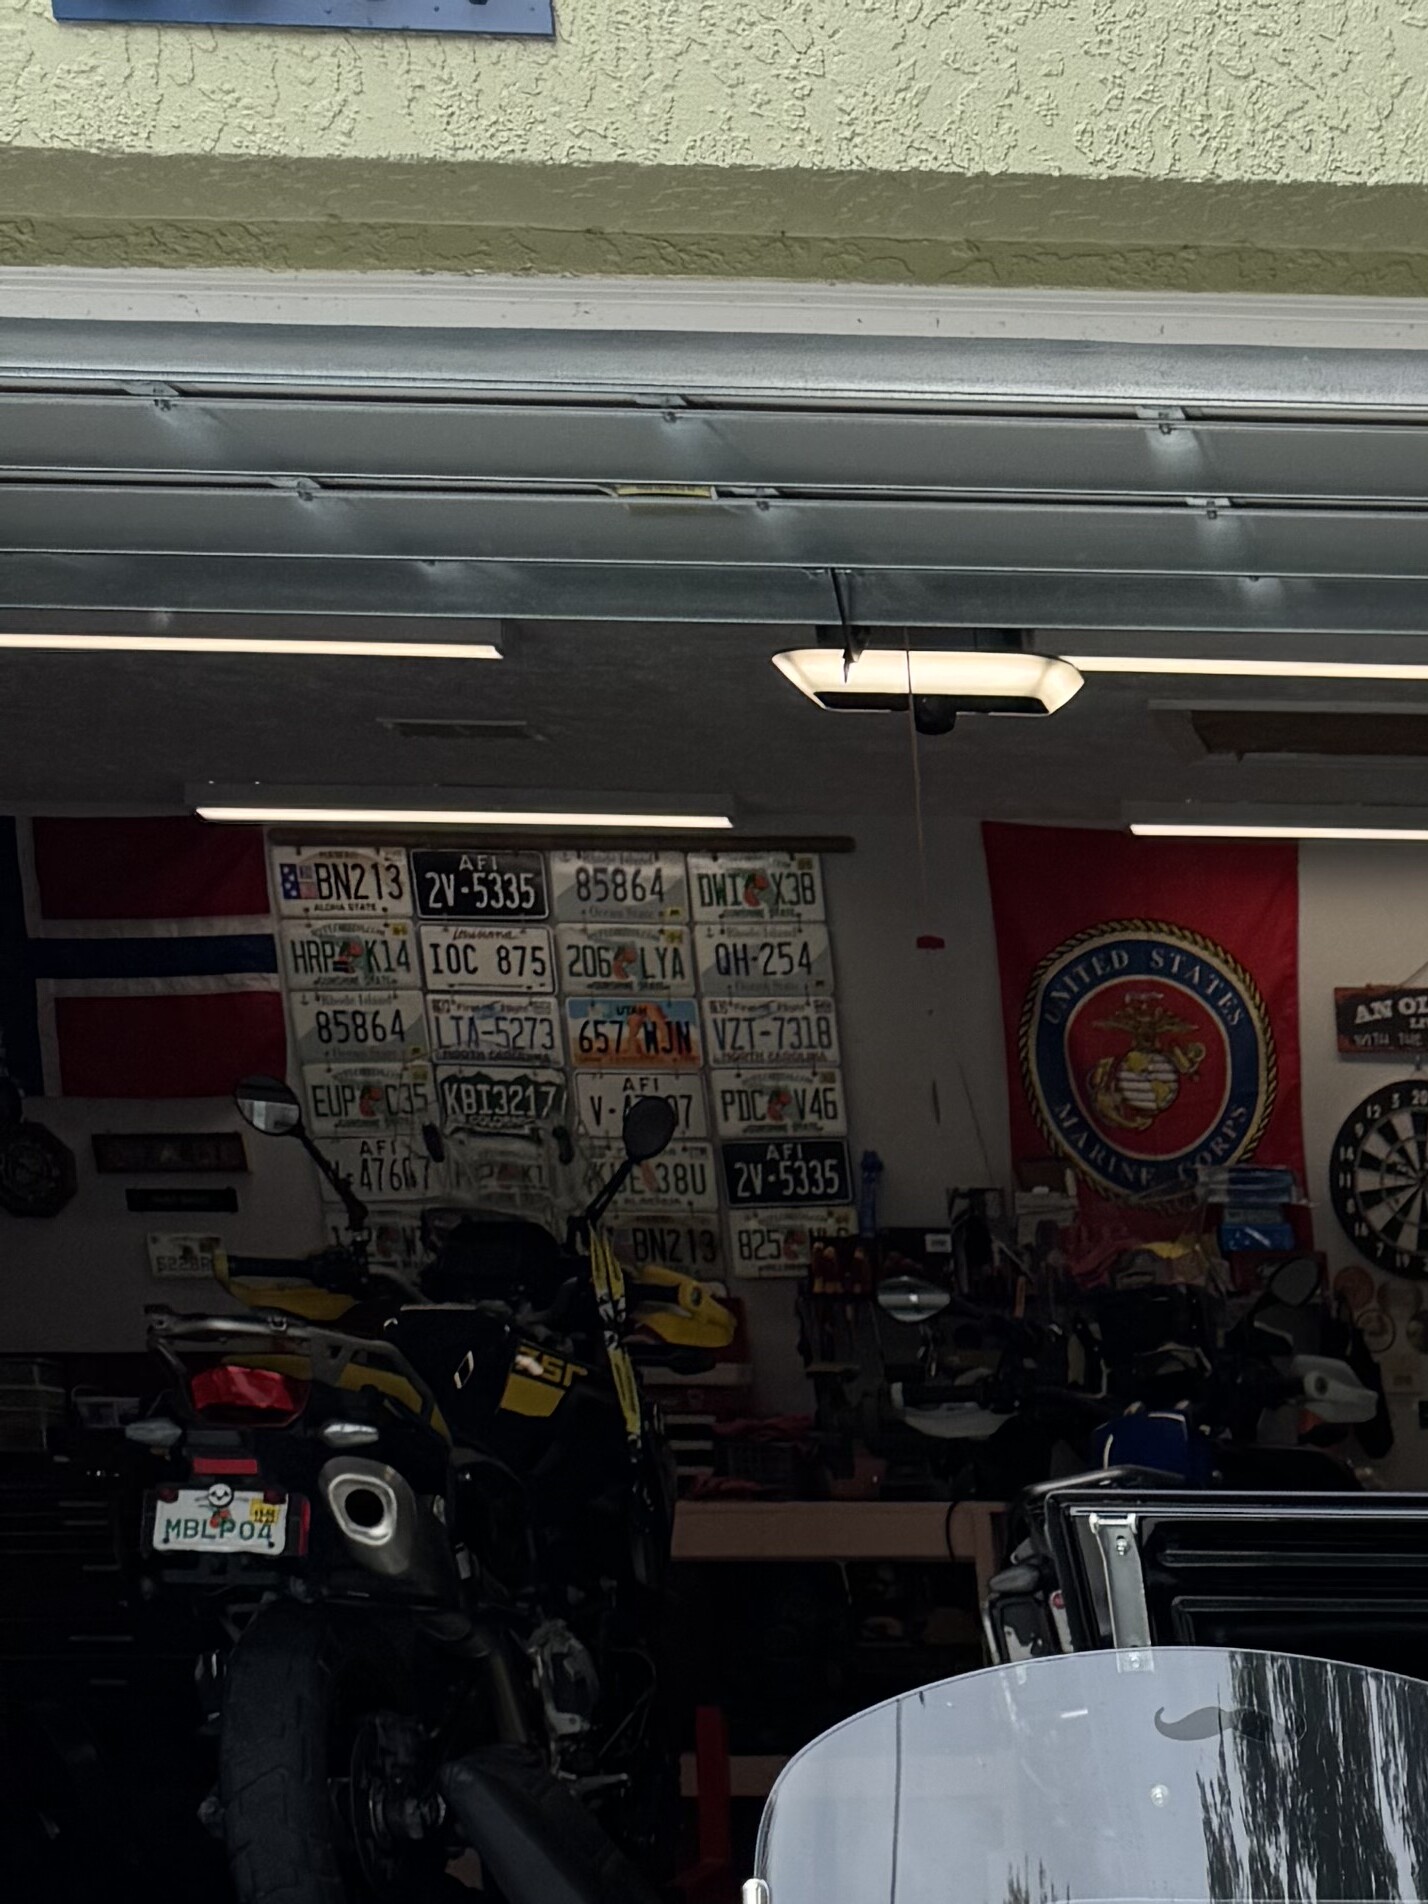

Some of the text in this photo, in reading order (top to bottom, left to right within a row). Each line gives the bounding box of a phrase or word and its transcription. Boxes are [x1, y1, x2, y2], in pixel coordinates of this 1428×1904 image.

[458, 854, 498, 871] AFI
[314, 862, 403, 900] BN213
[575, 866, 664, 903] 85864
[290, 939, 411, 973] HRP K14
[496, 944, 546, 977] 875
[566, 944, 685, 980] 206 LYA
[715, 941, 812, 977] QH-254
[1043, 948, 1245, 1027] UNITED STATES
[315, 1009, 405, 1043] 85864
[616, 1005, 647, 1015] UTAH
[1354, 999, 1393, 1026] AN
[434, 1015, 555, 1050] LTA-5273
[578, 1020, 623, 1054] 657
[1354, 1032, 1390, 1048] WITH
[311, 1084, 355, 1117] EUP
[622, 1077, 658, 1092] AFI
[720, 1087, 838, 1122] PDC V46
[360, 1140, 397, 1156] AFI
[766, 1143, 803, 1160] AFI
[1056, 1102, 1154, 1187] MARINE
[631, 1228, 716, 1263] BN213
